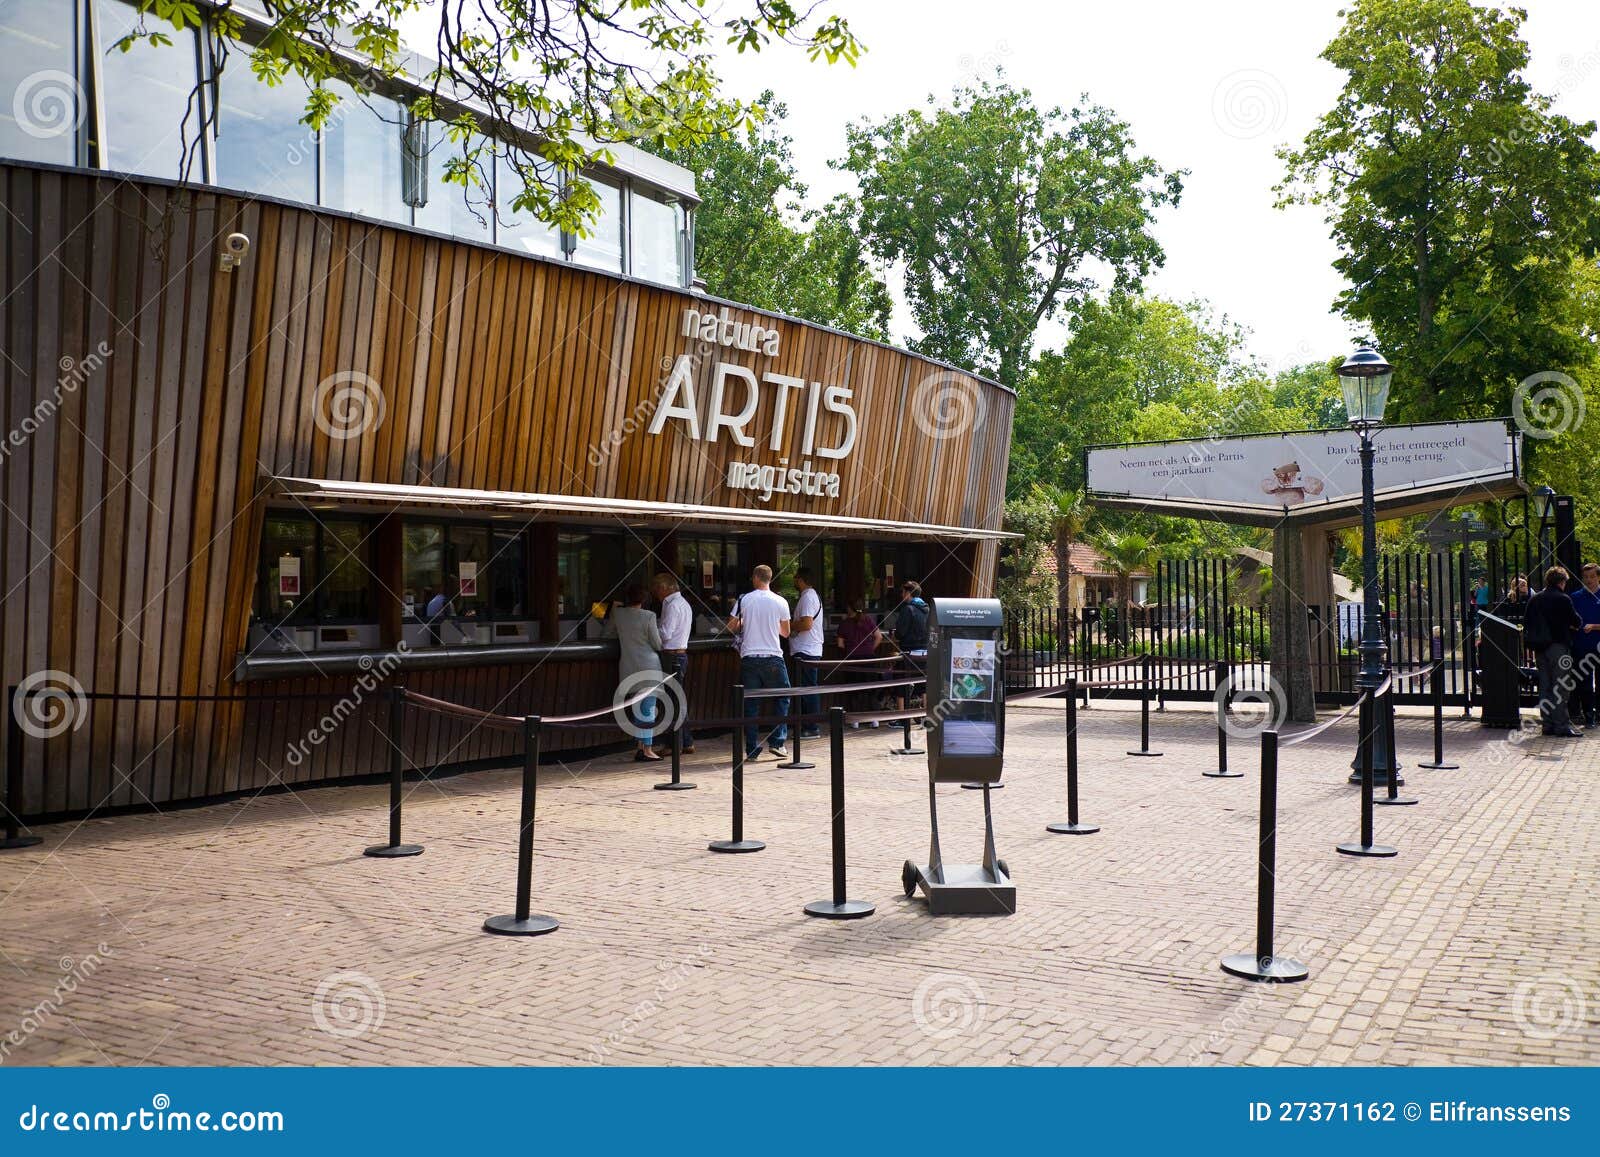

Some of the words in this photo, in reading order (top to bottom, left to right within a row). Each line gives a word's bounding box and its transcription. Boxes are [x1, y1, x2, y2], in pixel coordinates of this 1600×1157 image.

[681, 306, 780, 357] natura
[647, 354, 858, 460] ARTIS
[1327, 446, 1347, 455] Dan
[1390, 441, 1405, 451] het
[1408, 437, 1465, 452] entreegeld
[1391, 453, 1411, 464] nog
[727, 458, 840, 502] magistra
